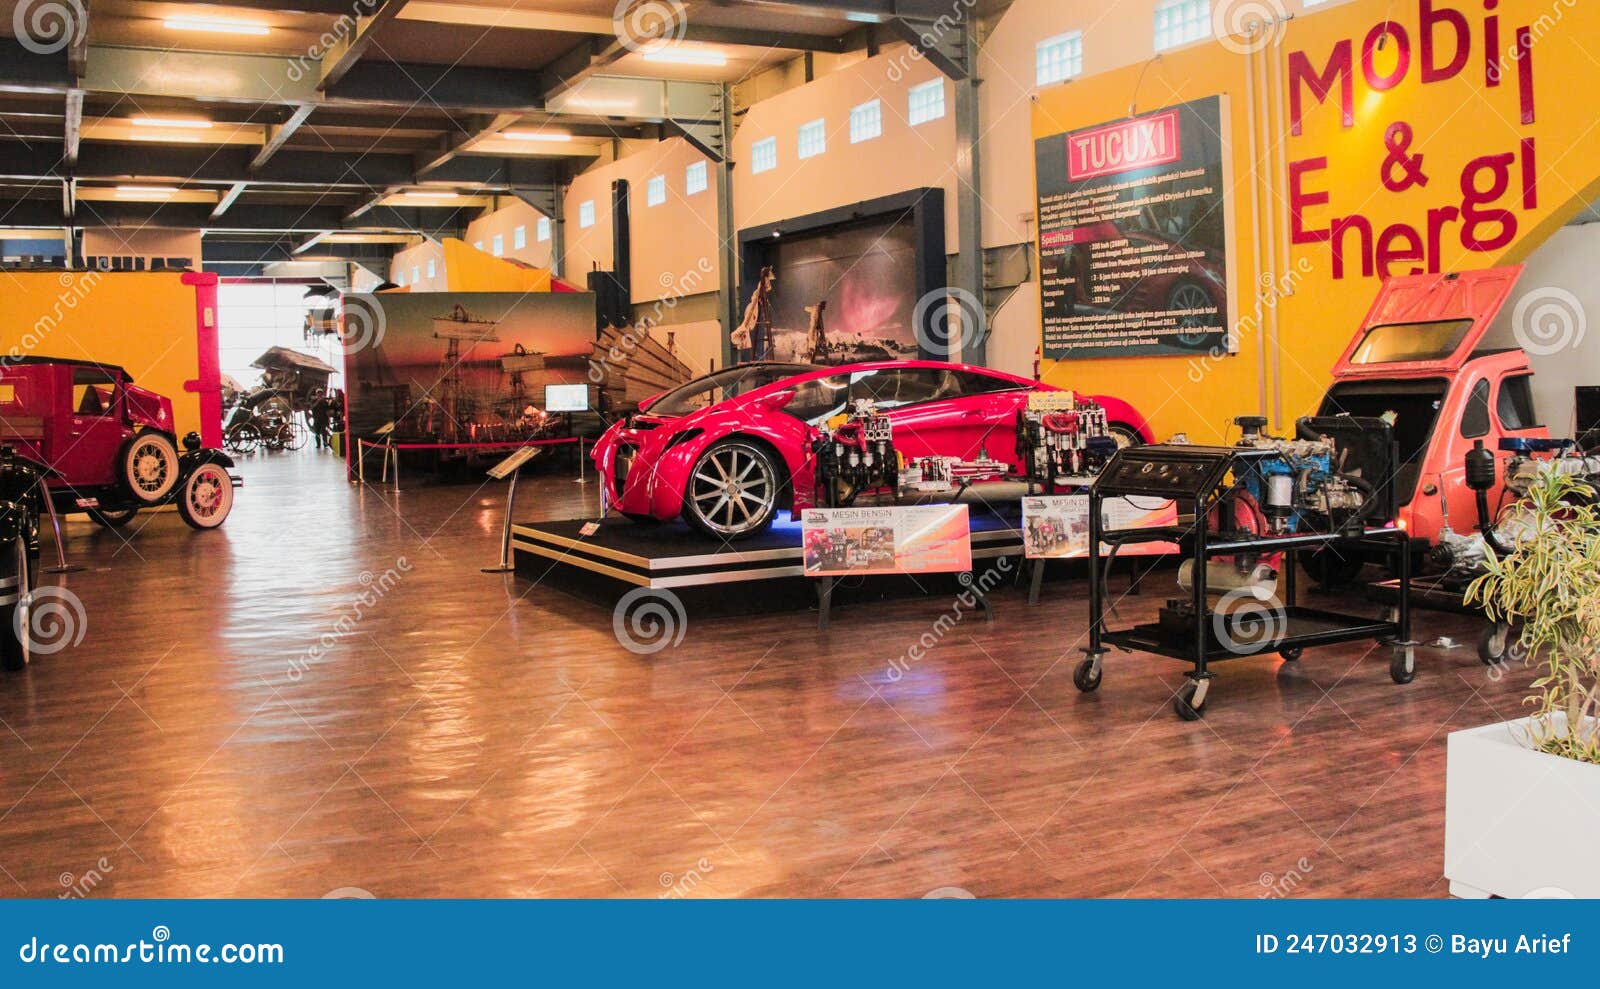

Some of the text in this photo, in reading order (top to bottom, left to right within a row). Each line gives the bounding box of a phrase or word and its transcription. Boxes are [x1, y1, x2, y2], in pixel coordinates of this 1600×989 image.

[1288, 0, 1535, 137] Mobil
[1077, 120, 1166, 171] TUCUXI
[1380, 121, 1429, 192] &
[1041, 231, 1074, 246] Spesifikasi
[832, 509, 892, 519] MESIN BENSIN
